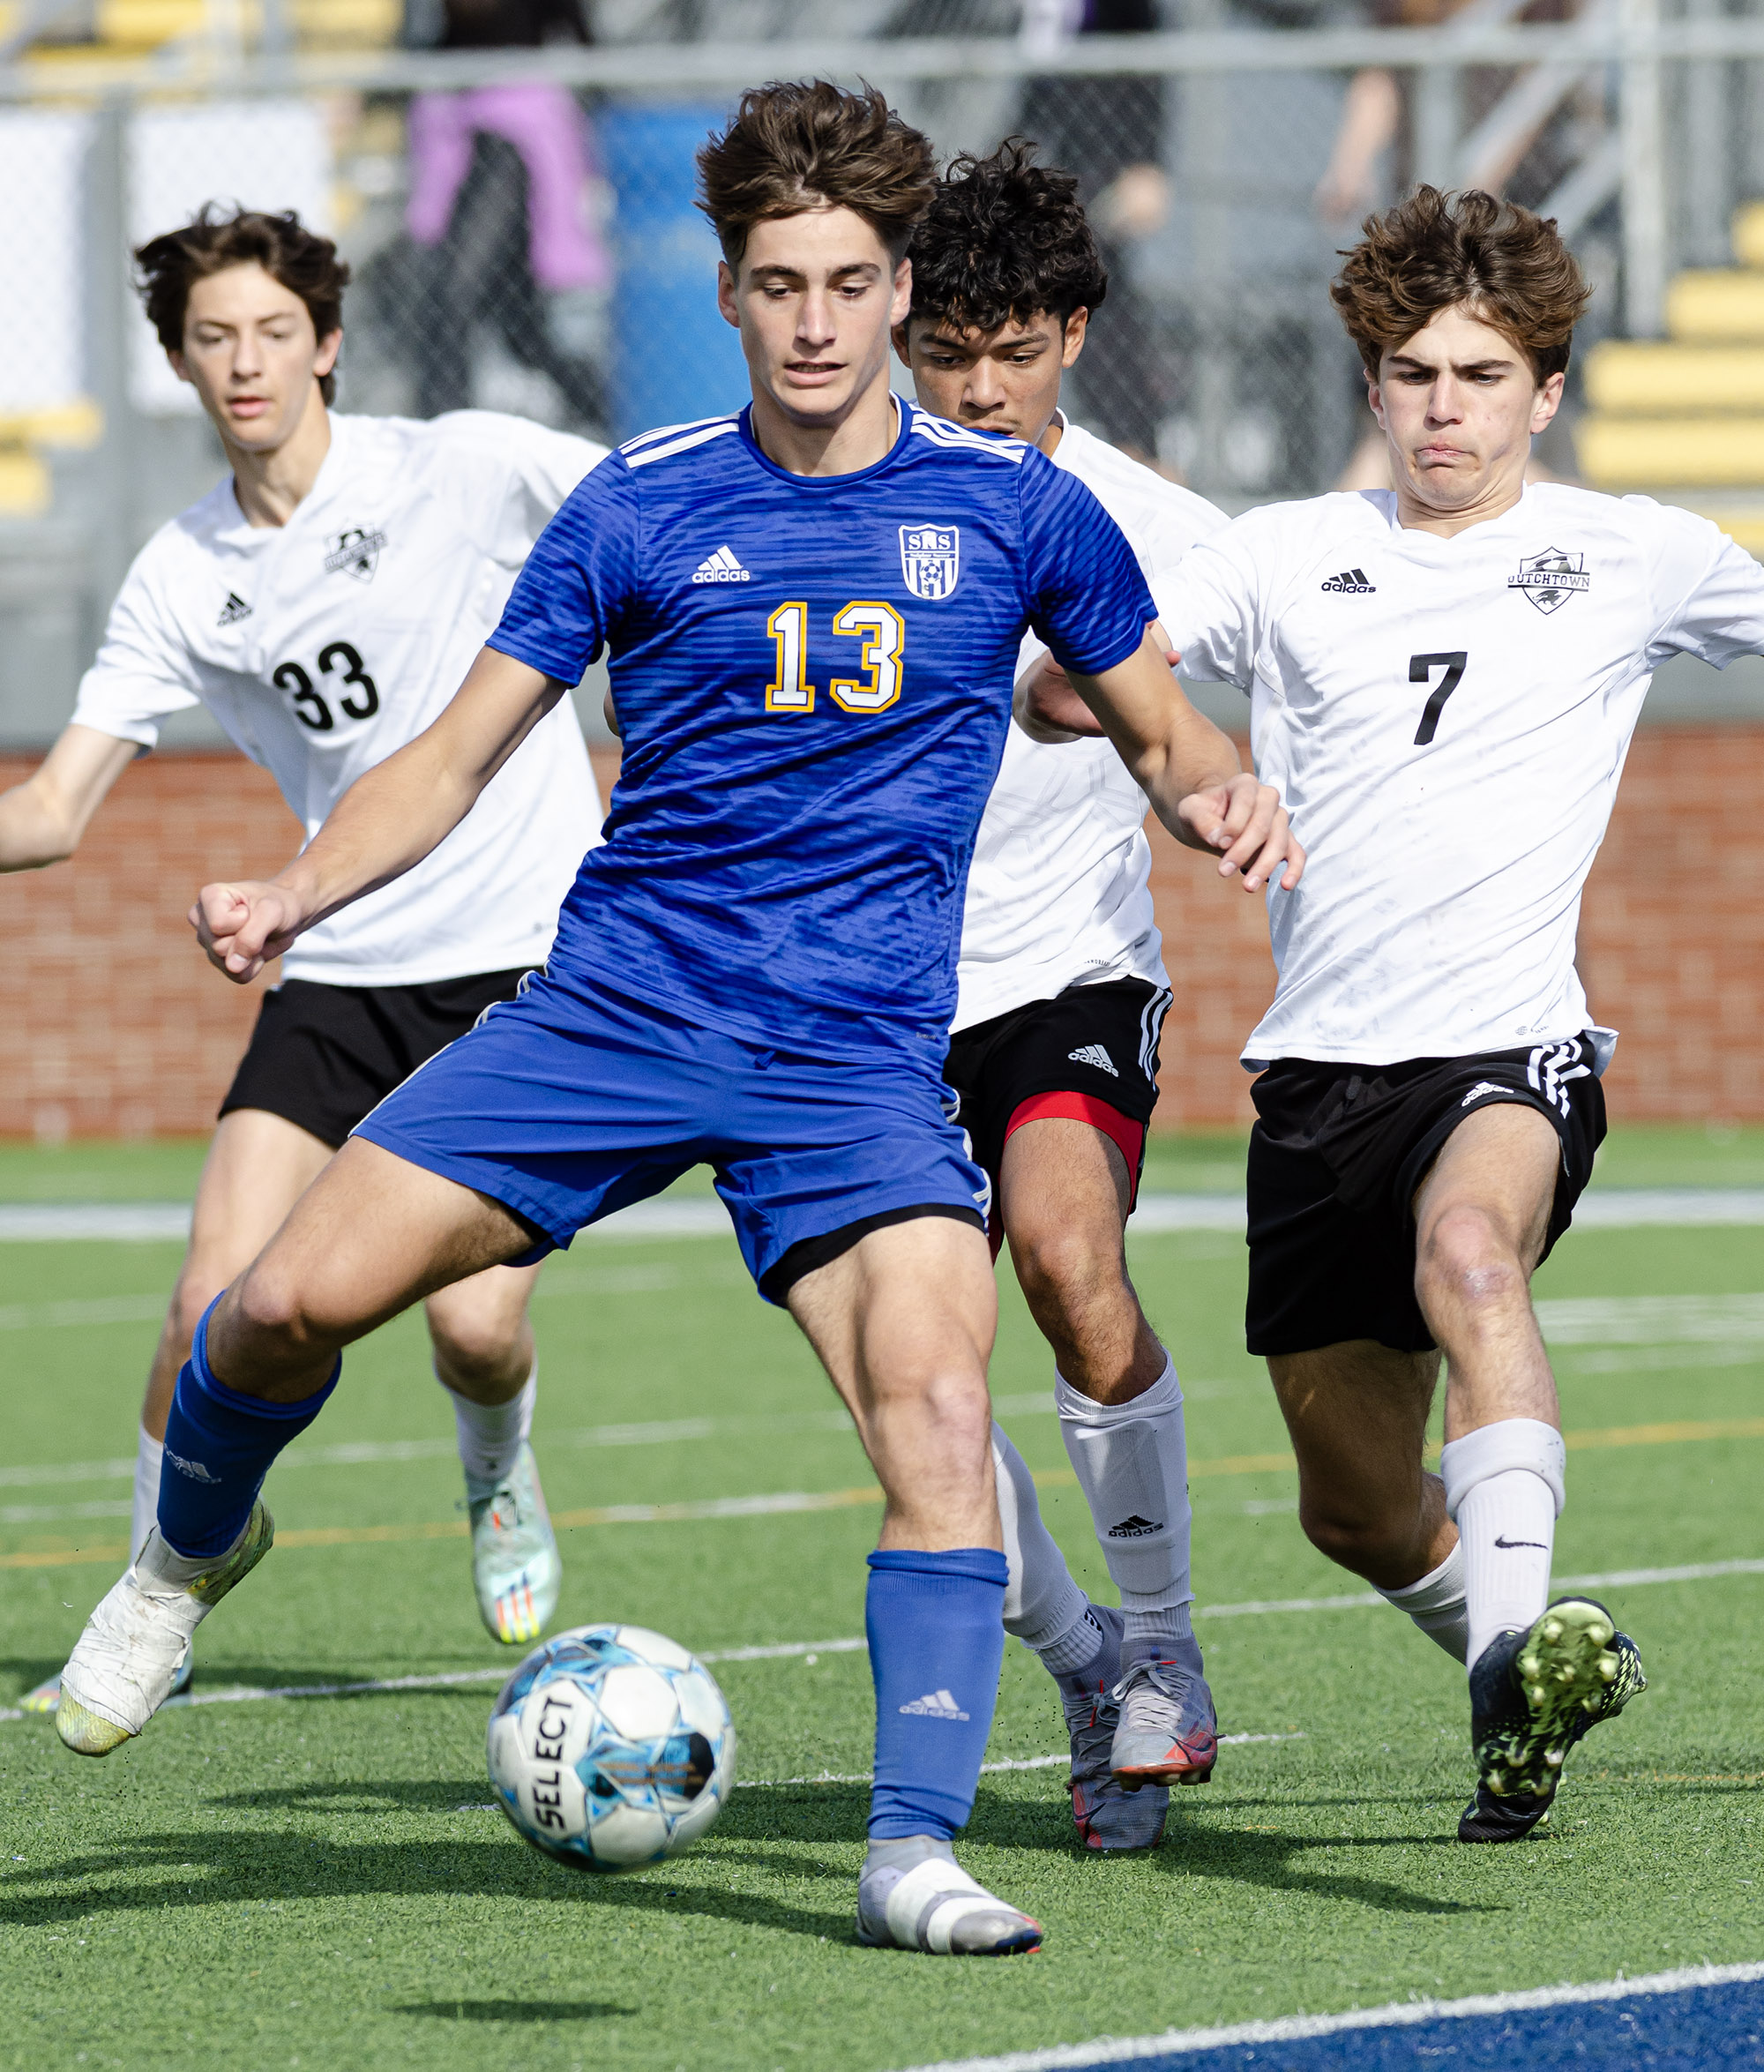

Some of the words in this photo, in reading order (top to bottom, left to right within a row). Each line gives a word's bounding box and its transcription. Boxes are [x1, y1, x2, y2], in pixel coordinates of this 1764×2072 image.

[692, 568, 751, 583] adidas
[1321, 581, 1377, 594] adidas
[273, 640, 379, 731] 33
[765, 601, 905, 714] 13
[1409, 651, 1469, 746] 7
[1067, 1052, 1119, 1078] adidas
[1108, 1522, 1164, 1538] adidas
[532, 1695, 573, 1830] SELECT
